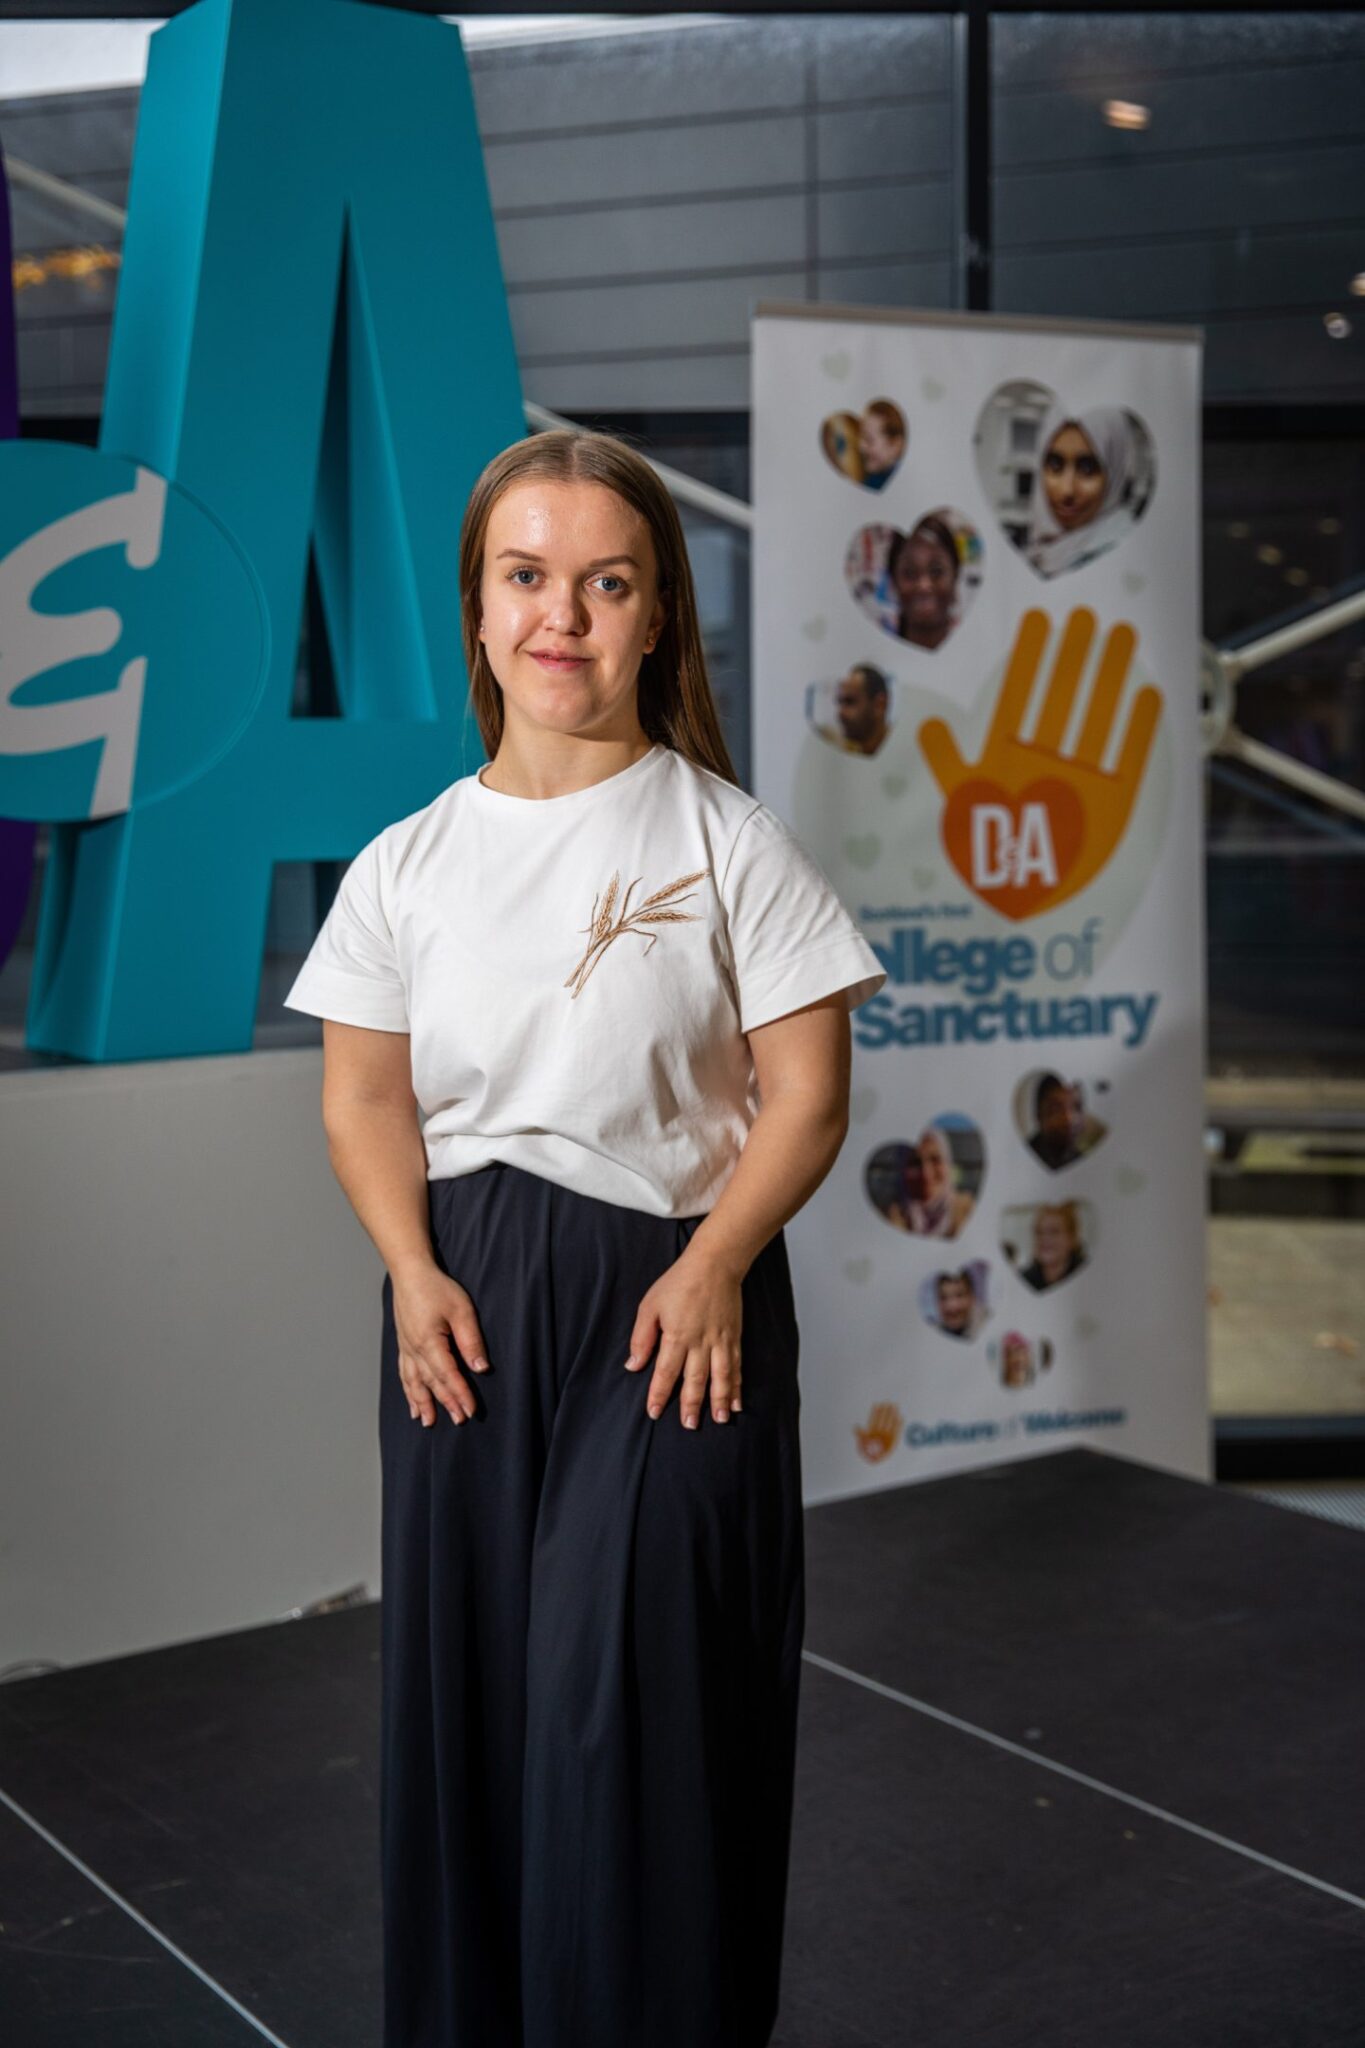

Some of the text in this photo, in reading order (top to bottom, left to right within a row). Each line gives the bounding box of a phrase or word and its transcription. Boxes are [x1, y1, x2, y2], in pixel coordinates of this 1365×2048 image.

[873, 918, 1100, 996] llege of
[853, 993, 1160, 1048] Sanctuary
